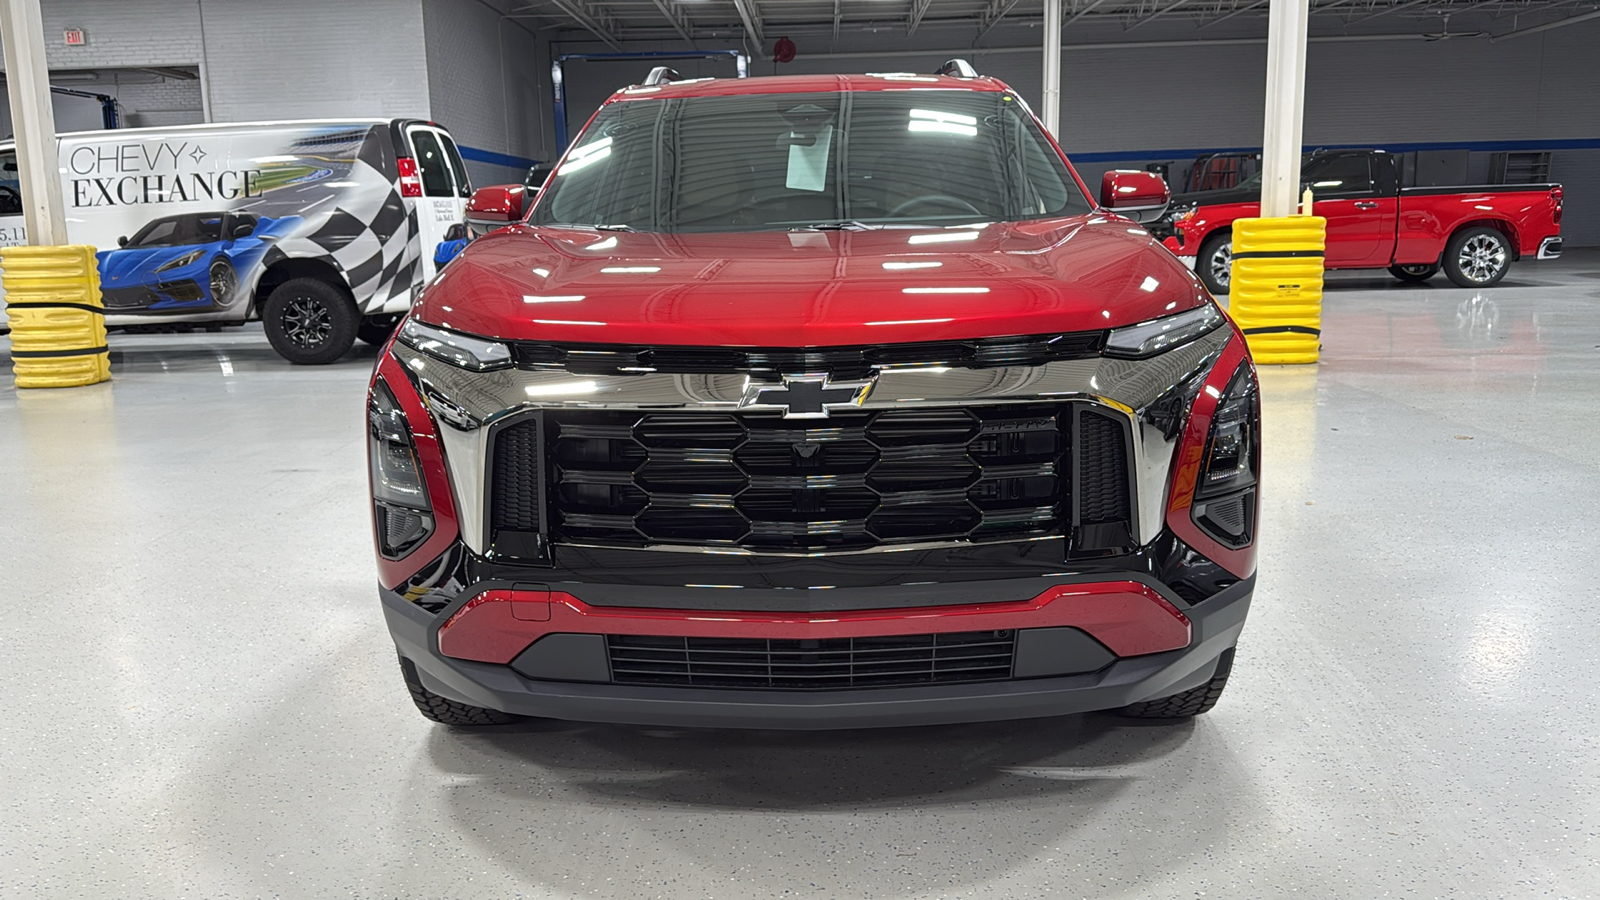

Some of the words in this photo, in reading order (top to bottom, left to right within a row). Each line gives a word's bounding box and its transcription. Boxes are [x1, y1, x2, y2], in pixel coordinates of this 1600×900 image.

[66, 31, 80, 43] EXIT
[70, 142, 188, 175] CHEVY
[71, 170, 263, 208] EXCHANGE
